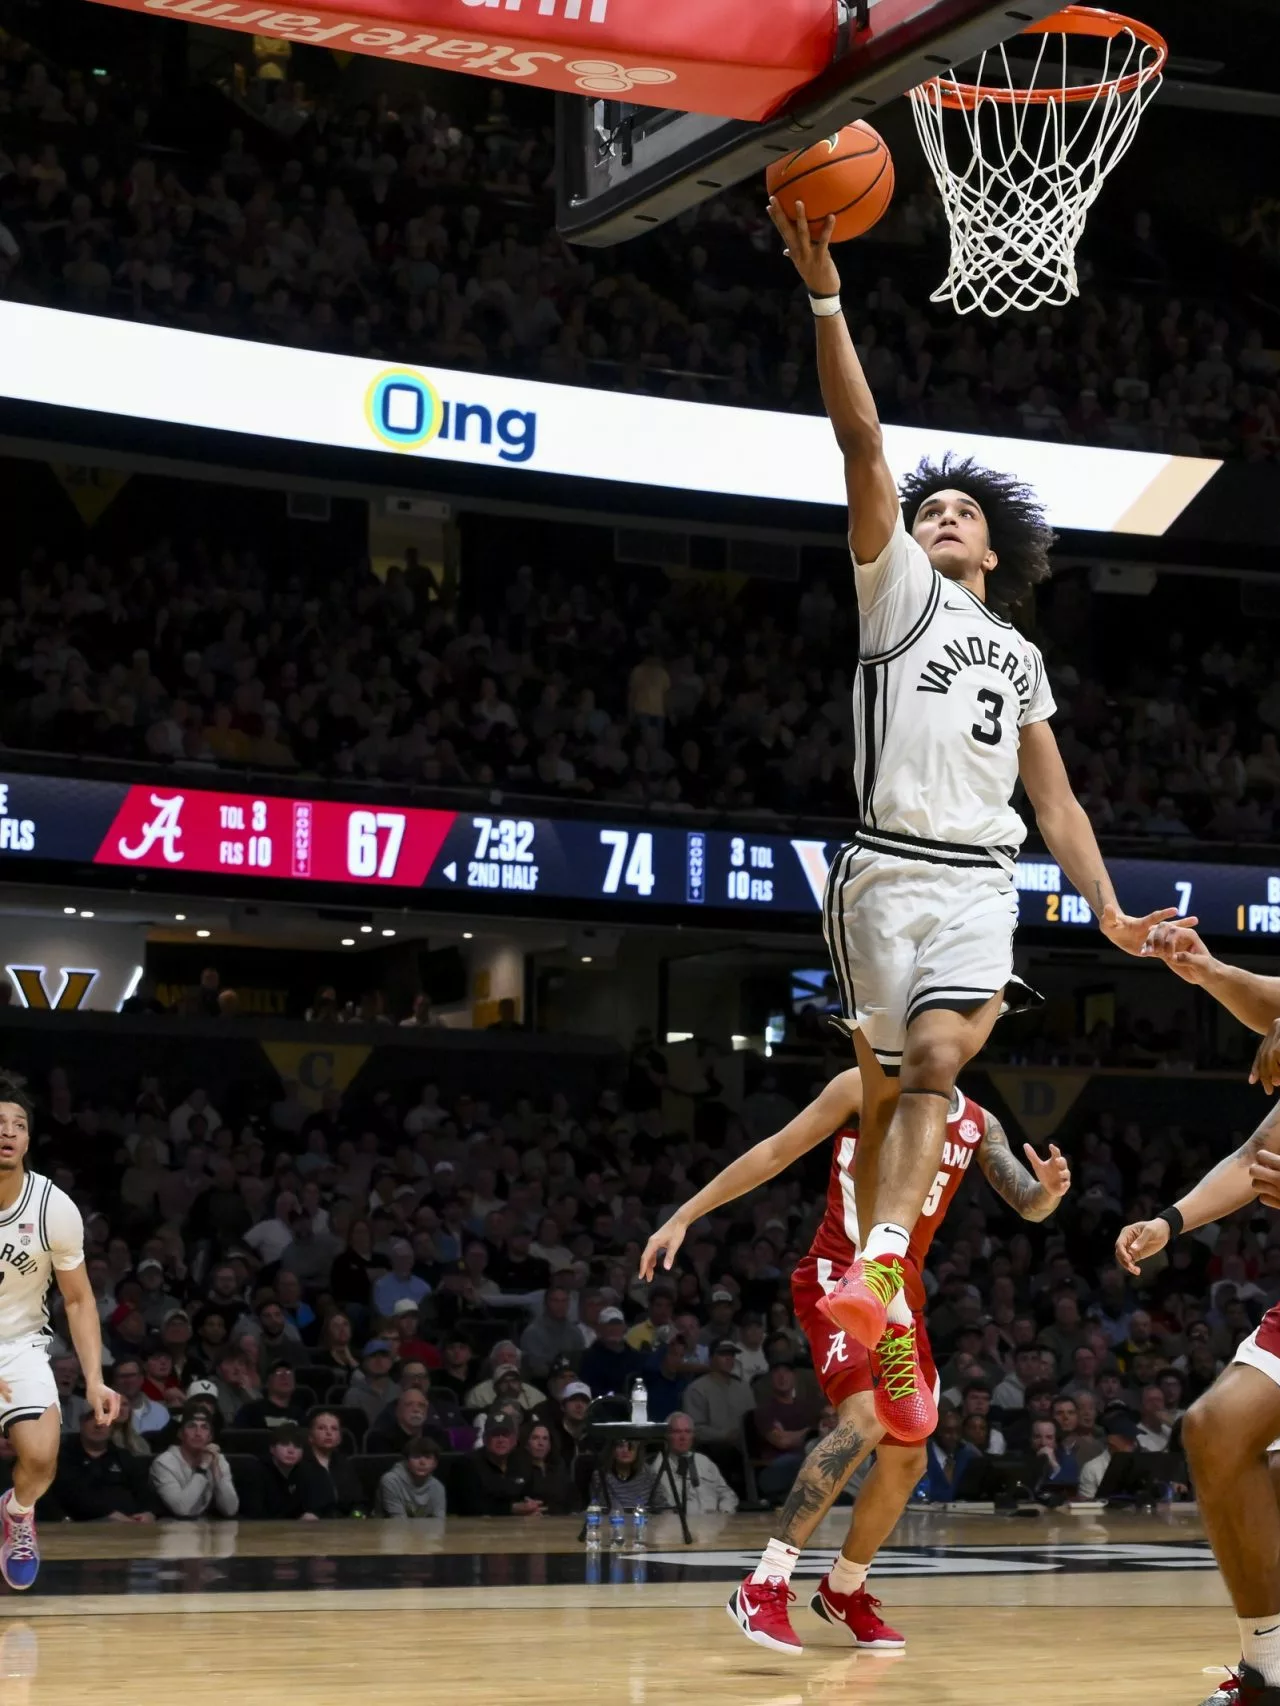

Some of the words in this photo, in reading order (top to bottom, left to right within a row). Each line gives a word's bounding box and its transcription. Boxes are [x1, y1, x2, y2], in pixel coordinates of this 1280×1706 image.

[971, 687, 1004, 746] 3
[220, 805, 245, 830] TOL
[252, 800, 267, 831] 3
[0, 818, 36, 851] FLS
[219, 841, 244, 865] FLS
[248, 836, 272, 867] 10
[347, 810, 406, 878] 67
[473, 817, 535, 863] 7:32
[600, 829, 655, 896] 74
[730, 837, 745, 867] 3
[750, 846, 774, 869] TOL
[467, 862, 500, 889] 2ND
[502, 864, 539, 891] HALF
[727, 871, 750, 900] 10
[751, 879, 773, 901] FLS
[1046, 894, 1059, 922] 2
[1061, 894, 1092, 924] FLS
[1175, 882, 1192, 917] 7
[1236, 905, 1245, 932] 1
[1249, 907, 1280, 933] PTS
[299, 1052, 333, 1090] C
[1022, 1081, 1056, 1116] D
[921, 1171, 950, 1217] 5
